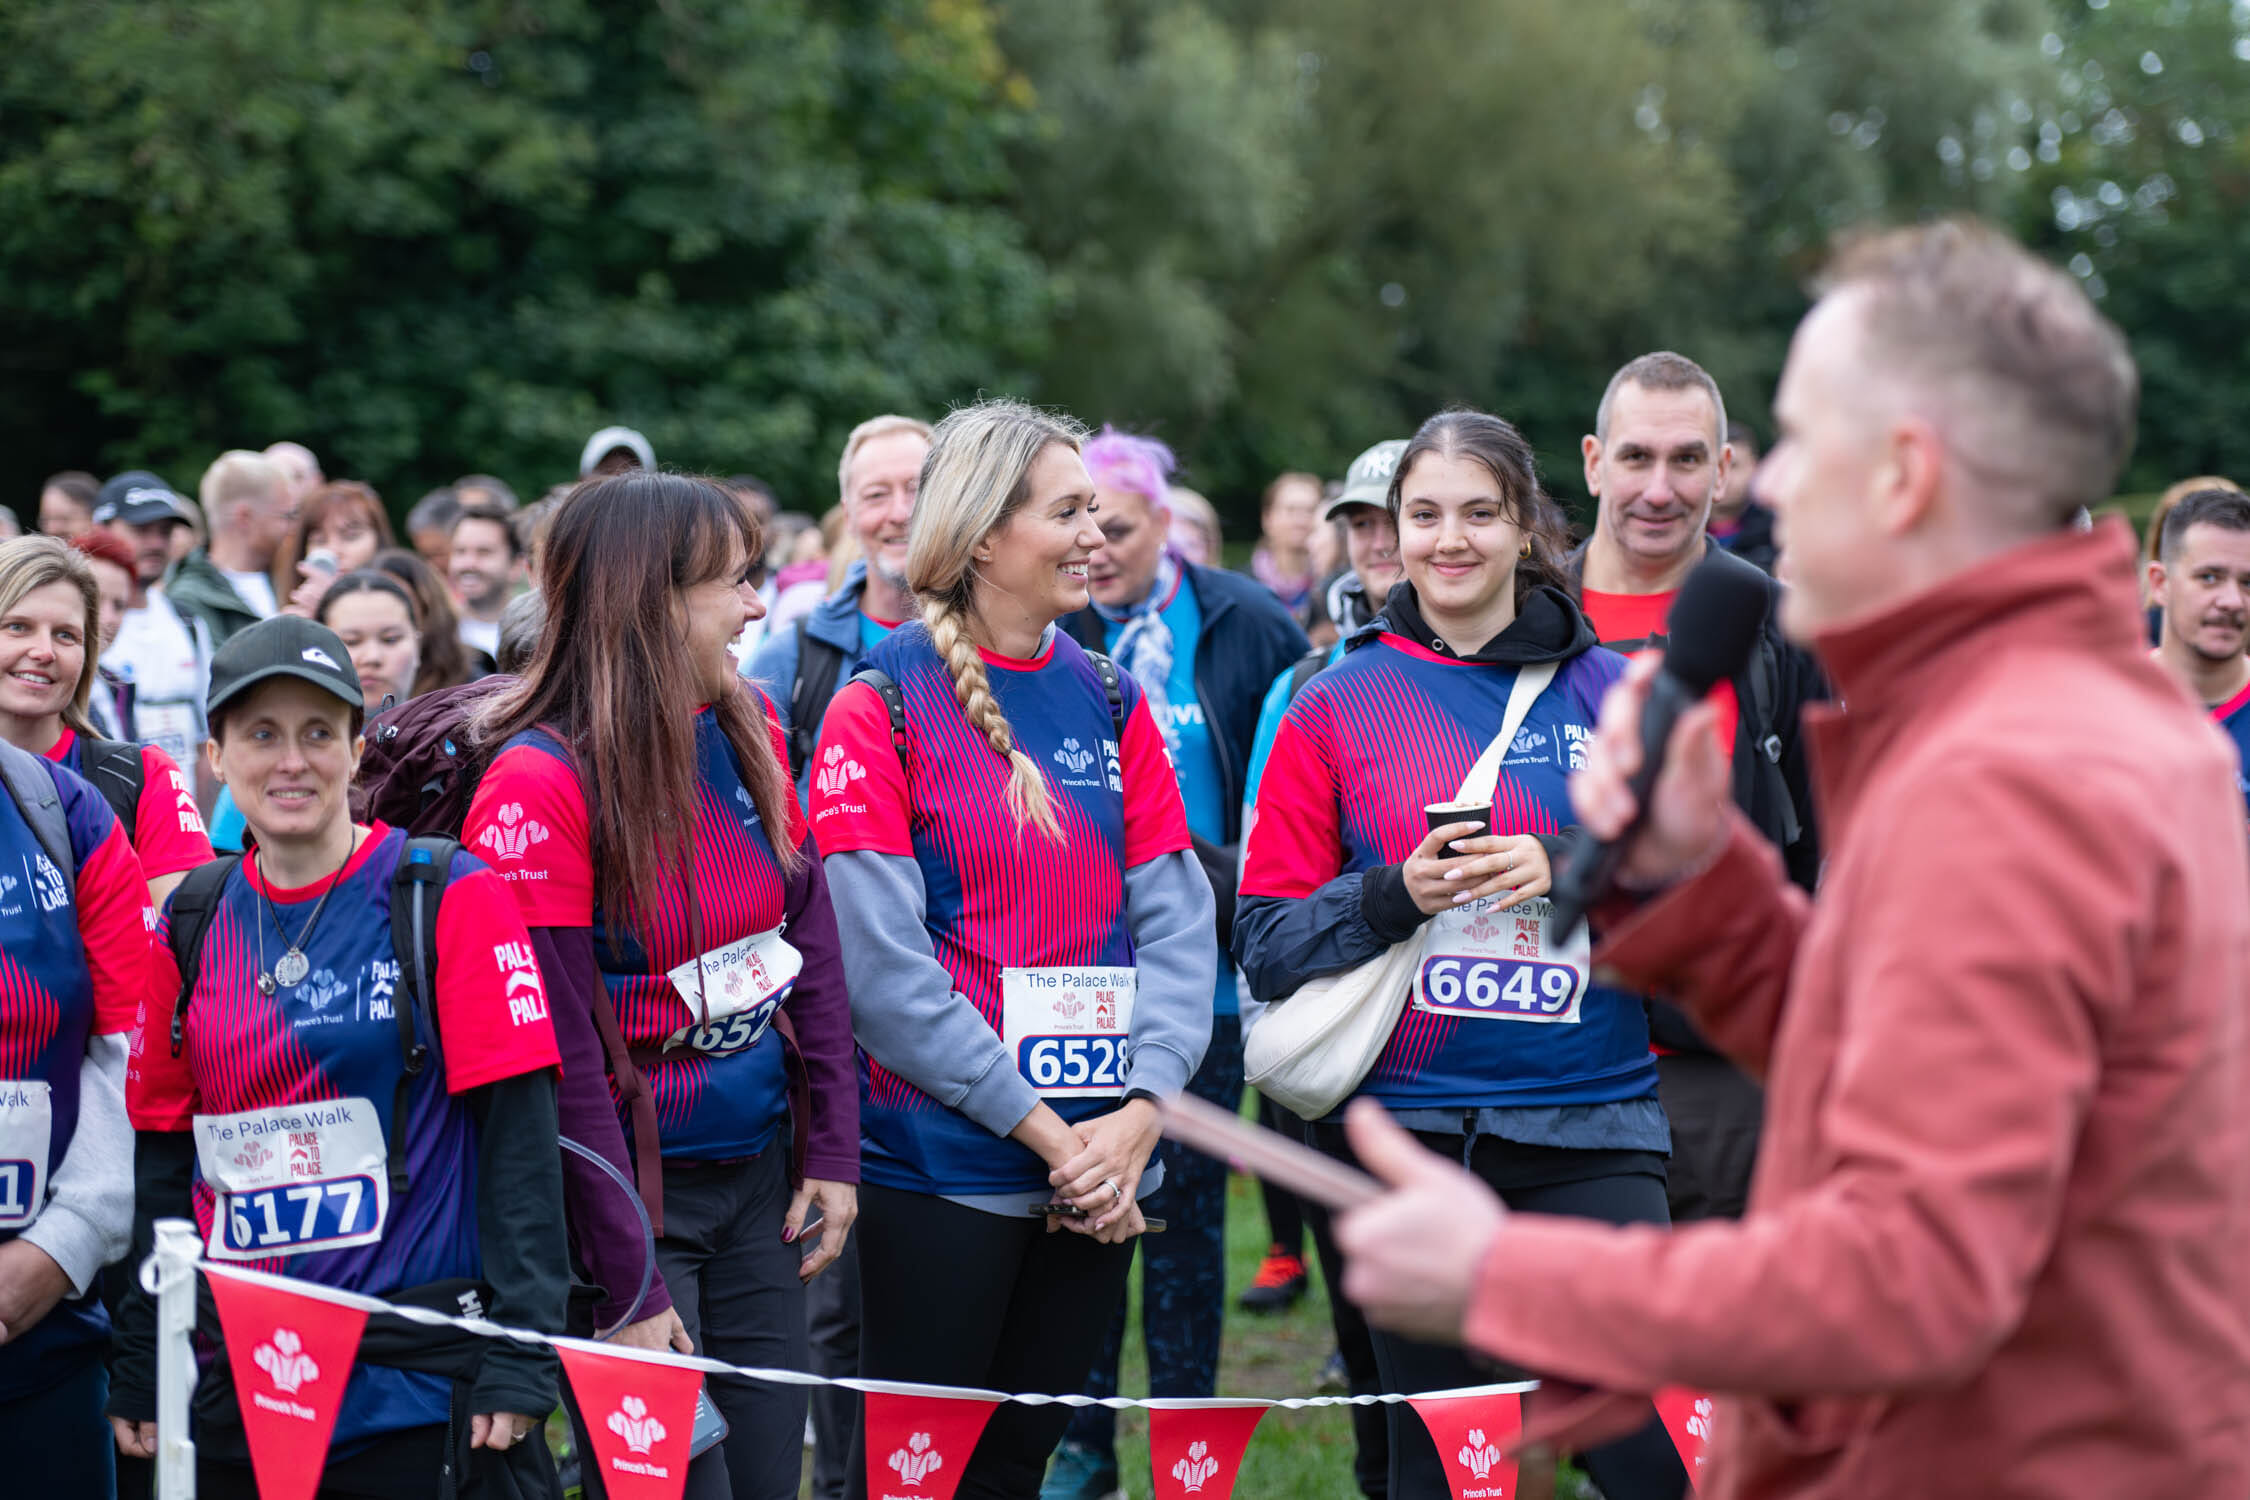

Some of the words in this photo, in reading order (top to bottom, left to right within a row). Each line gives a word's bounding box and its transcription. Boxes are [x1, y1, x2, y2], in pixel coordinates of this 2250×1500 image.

[1103, 739, 1119, 758] PAL
[1530, 755, 1550, 764] Trust
[1109, 774, 1123, 793] PAL
[840, 803, 867, 813] Trust
[519, 869, 549, 880] Trust
[1476, 898, 1531, 915] Pce
[1515, 918, 1539, 933] PALACE
[1530, 933, 1539, 945] TO
[1514, 944, 1539, 957] PALACE
[693, 961, 720, 977] he
[1026, 973, 1056, 988] The
[1062, 973, 1107, 988] Palace
[1429, 960, 1572, 1012] 6649
[1096, 991, 1115, 1004] PALACE
[370, 999, 396, 1020] PAL
[323, 1014, 344, 1023] Trust
[1096, 1017, 1116, 1030] PALACE
[1029, 1039, 1130, 1085] 6528
[239, 1116, 302, 1138] Palace
[305, 1106, 353, 1128] Walk
[289, 1132, 318, 1147] PALACE
[310, 1147, 320, 1160] TO
[290, 1162, 323, 1177] PALACE
[231, 1180, 363, 1248] 6177
[1463, 1487, 1487, 1498] Prince's
[1486, 1487, 1502, 1497] Trust
